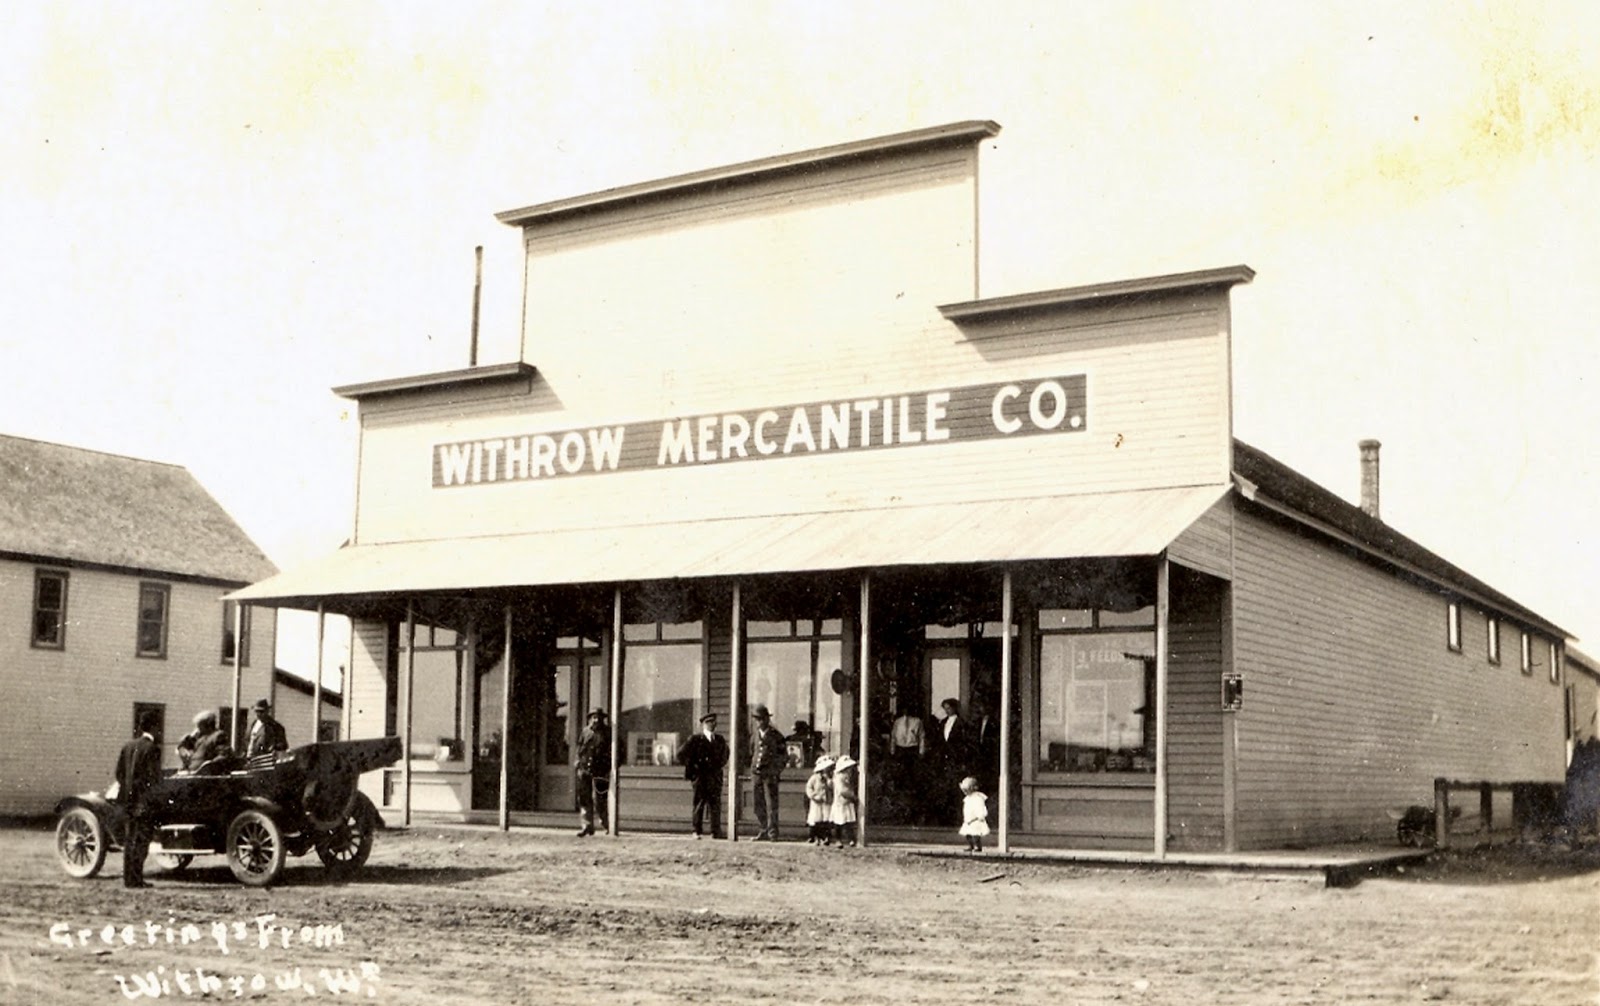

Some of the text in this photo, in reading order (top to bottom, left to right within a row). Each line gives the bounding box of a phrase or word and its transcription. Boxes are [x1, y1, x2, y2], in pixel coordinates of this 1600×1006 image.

[439, 380, 1082, 485] WITHROW MERCANTILE CO.
